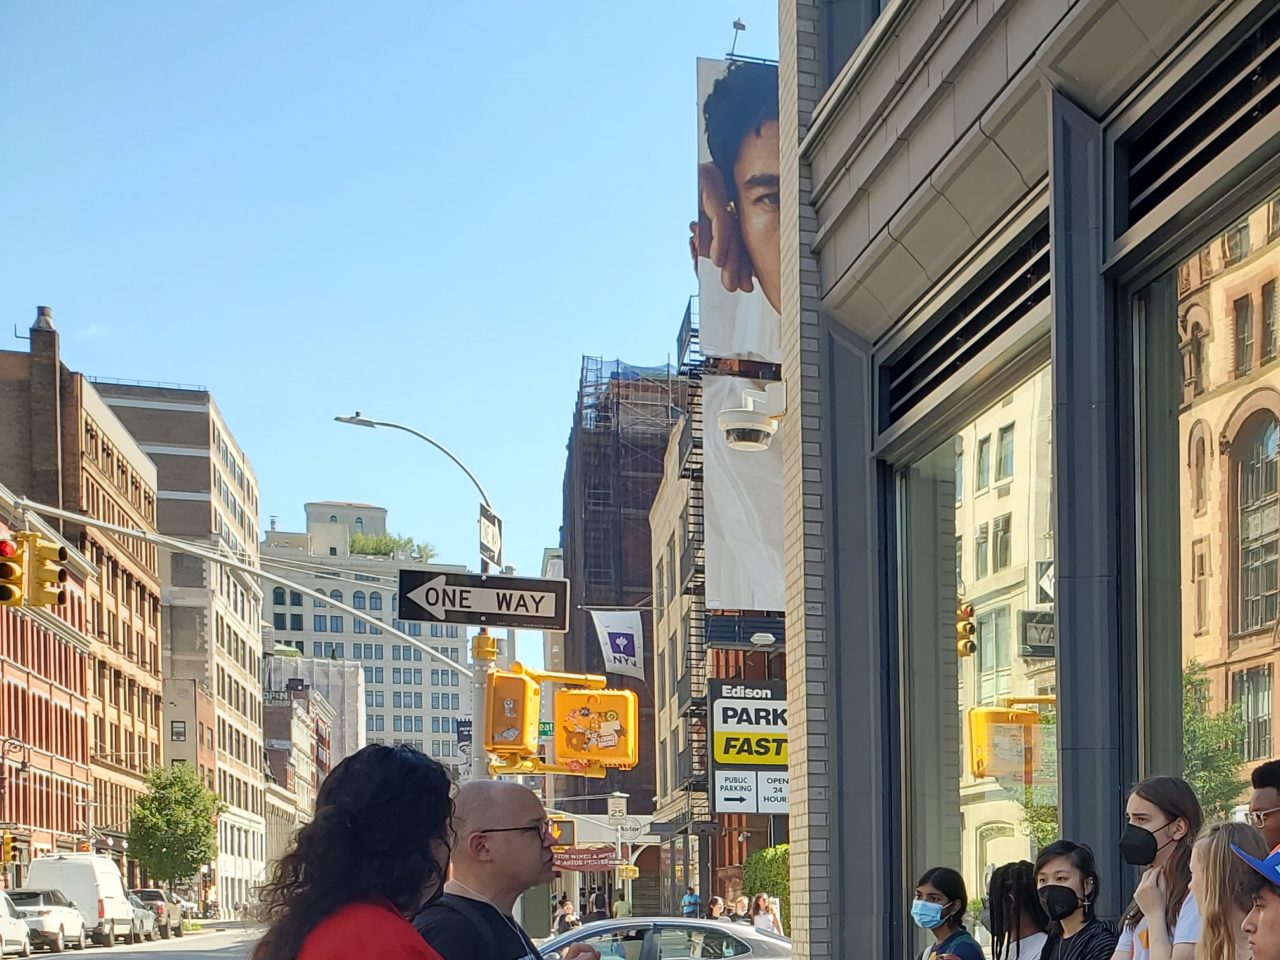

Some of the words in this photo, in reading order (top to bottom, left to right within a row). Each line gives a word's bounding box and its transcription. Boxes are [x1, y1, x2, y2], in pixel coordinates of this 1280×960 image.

[425, 587, 472, 609] ONE
[496, 592, 546, 614] WAY
[722, 685, 772, 698] Edison
[722, 707, 788, 726] PARK
[723, 737, 788, 756] FAST
